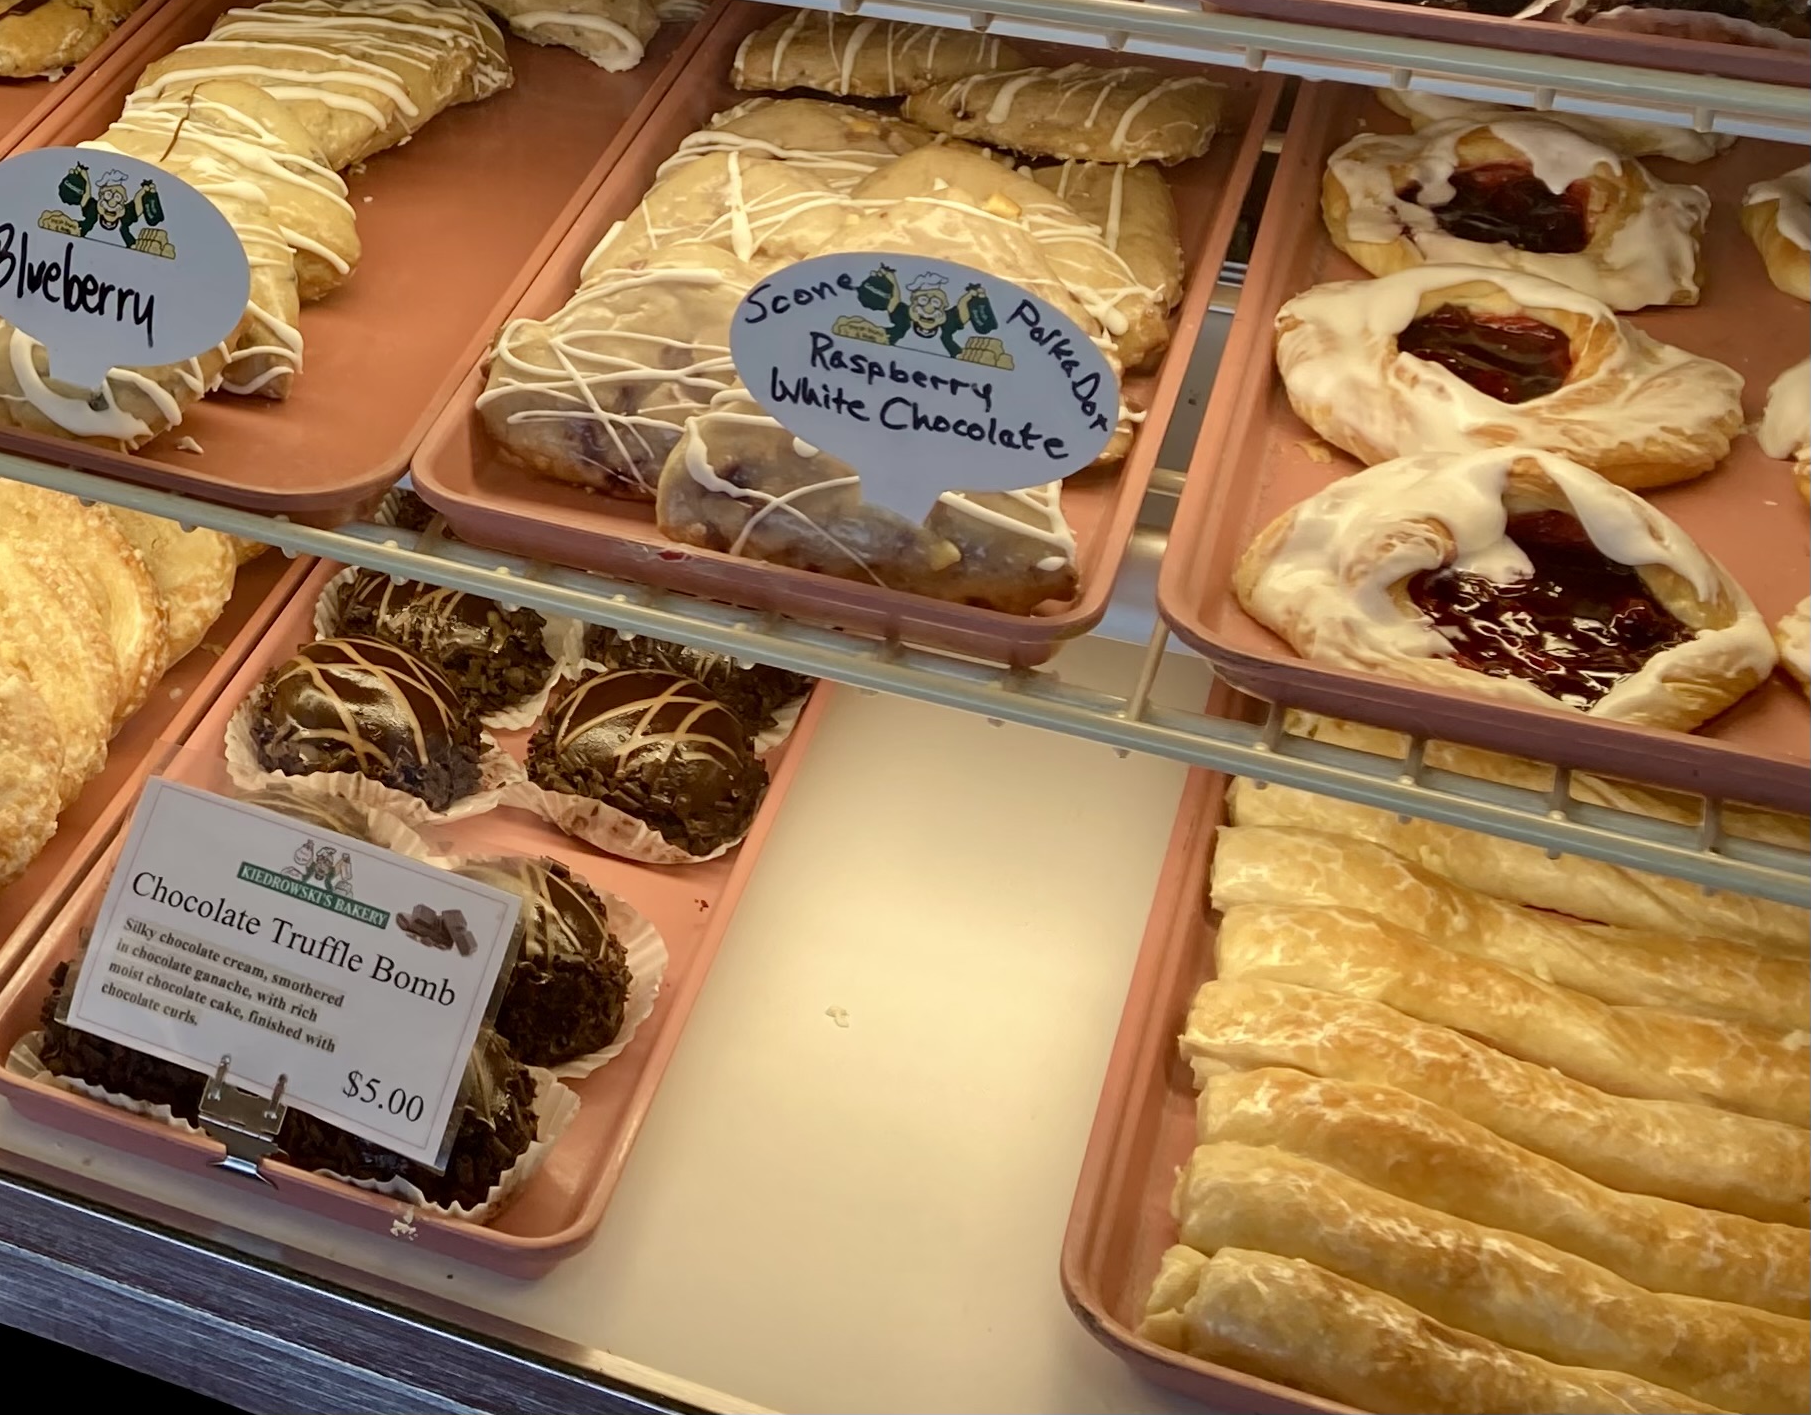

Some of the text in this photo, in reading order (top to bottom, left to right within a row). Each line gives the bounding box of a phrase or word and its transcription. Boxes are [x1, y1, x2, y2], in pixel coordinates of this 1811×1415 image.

[745, 273, 854, 323] Scone
[771, 367, 1069, 459] White Chocolate
[810, 331, 993, 412] Raspberry
[240, 865, 388, 928] KIEDROWSKI'S BAKERY
[116, 938, 318, 1023] in chocolate ganache, with rich
[123, 917, 345, 1008] Silky chocolate cream, smothered
[132, 871, 456, 1007] Chocolate Truffle Bomb
[101, 980, 198, 1027] chocolate curls.
[108, 960, 336, 1053] moist chocolate cake, finished with
[342, 1069, 425, 1123] $5.00
